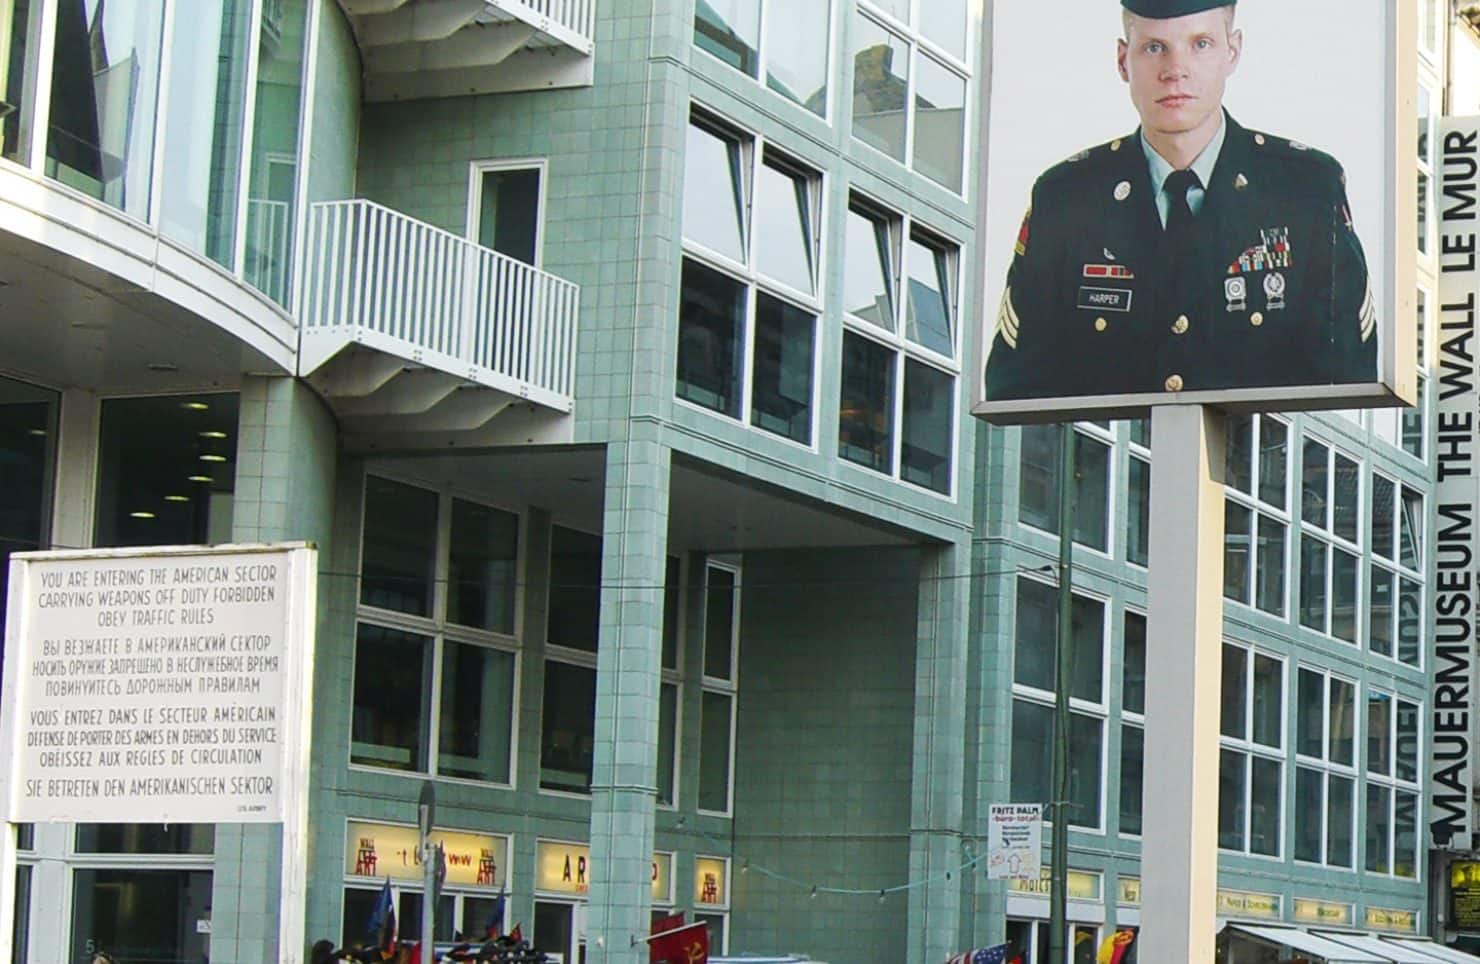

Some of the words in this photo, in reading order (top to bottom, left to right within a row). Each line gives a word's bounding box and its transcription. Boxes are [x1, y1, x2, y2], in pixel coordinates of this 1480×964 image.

[1442, 130, 1478, 221] MUR
[1441, 233, 1475, 272] LE
[1089, 293, 1119, 305] HARPER
[1439, 293, 1474, 401] WALL
[1437, 411, 1472, 482] THE
[41, 572, 62, 588] YOU
[68, 571, 88, 587] ARE
[94, 569, 144, 586] ENTERING
[150, 568, 167, 584] THE
[173, 566, 229, 584] AMERICAN
[235, 565, 276, 582] SECTOR
[39, 592, 93, 608] CARRYING
[98, 590, 151, 606] WEAPONS
[155, 588, 175, 605] OFF
[181, 588, 208, 604] DUTY
[213, 586, 275, 603] FORBIDDEN
[98, 610, 127, 627] OBEY
[132, 609, 175, 625] TRAFFIC
[181, 608, 214, 625] RULES
[1432, 503, 1472, 833] MAUERMUSEUM
[30, 710, 58, 726] VOUS
[64, 709, 103, 725] ENTREZ
[108, 708, 138, 724] DANS
[143, 707, 153, 724] LE
[159, 707, 207, 724] SECTEUR
[67, 730, 79, 746] DE
[80, 729, 112, 746] PORTER
[114, 729, 132, 745] DES
[133, 729, 164, 745] ARMES
[167, 729, 179, 744] EN
[182, 728, 219, 744] DEHORS
[222, 727, 236, 744] DU
[238, 727, 277, 743] SERVICE
[98, 750, 121, 767] AUX
[171, 749, 184, 765] DE
[191, 748, 262, 765] CIRCULATION
[26, 779, 41, 797] SIE
[47, 779, 99, 797] BETRETEN
[104, 779, 125, 796] DEN
[129, 777, 226, 796] AMERIKANISCHEN
[231, 776, 273, 795] SEKTOR
